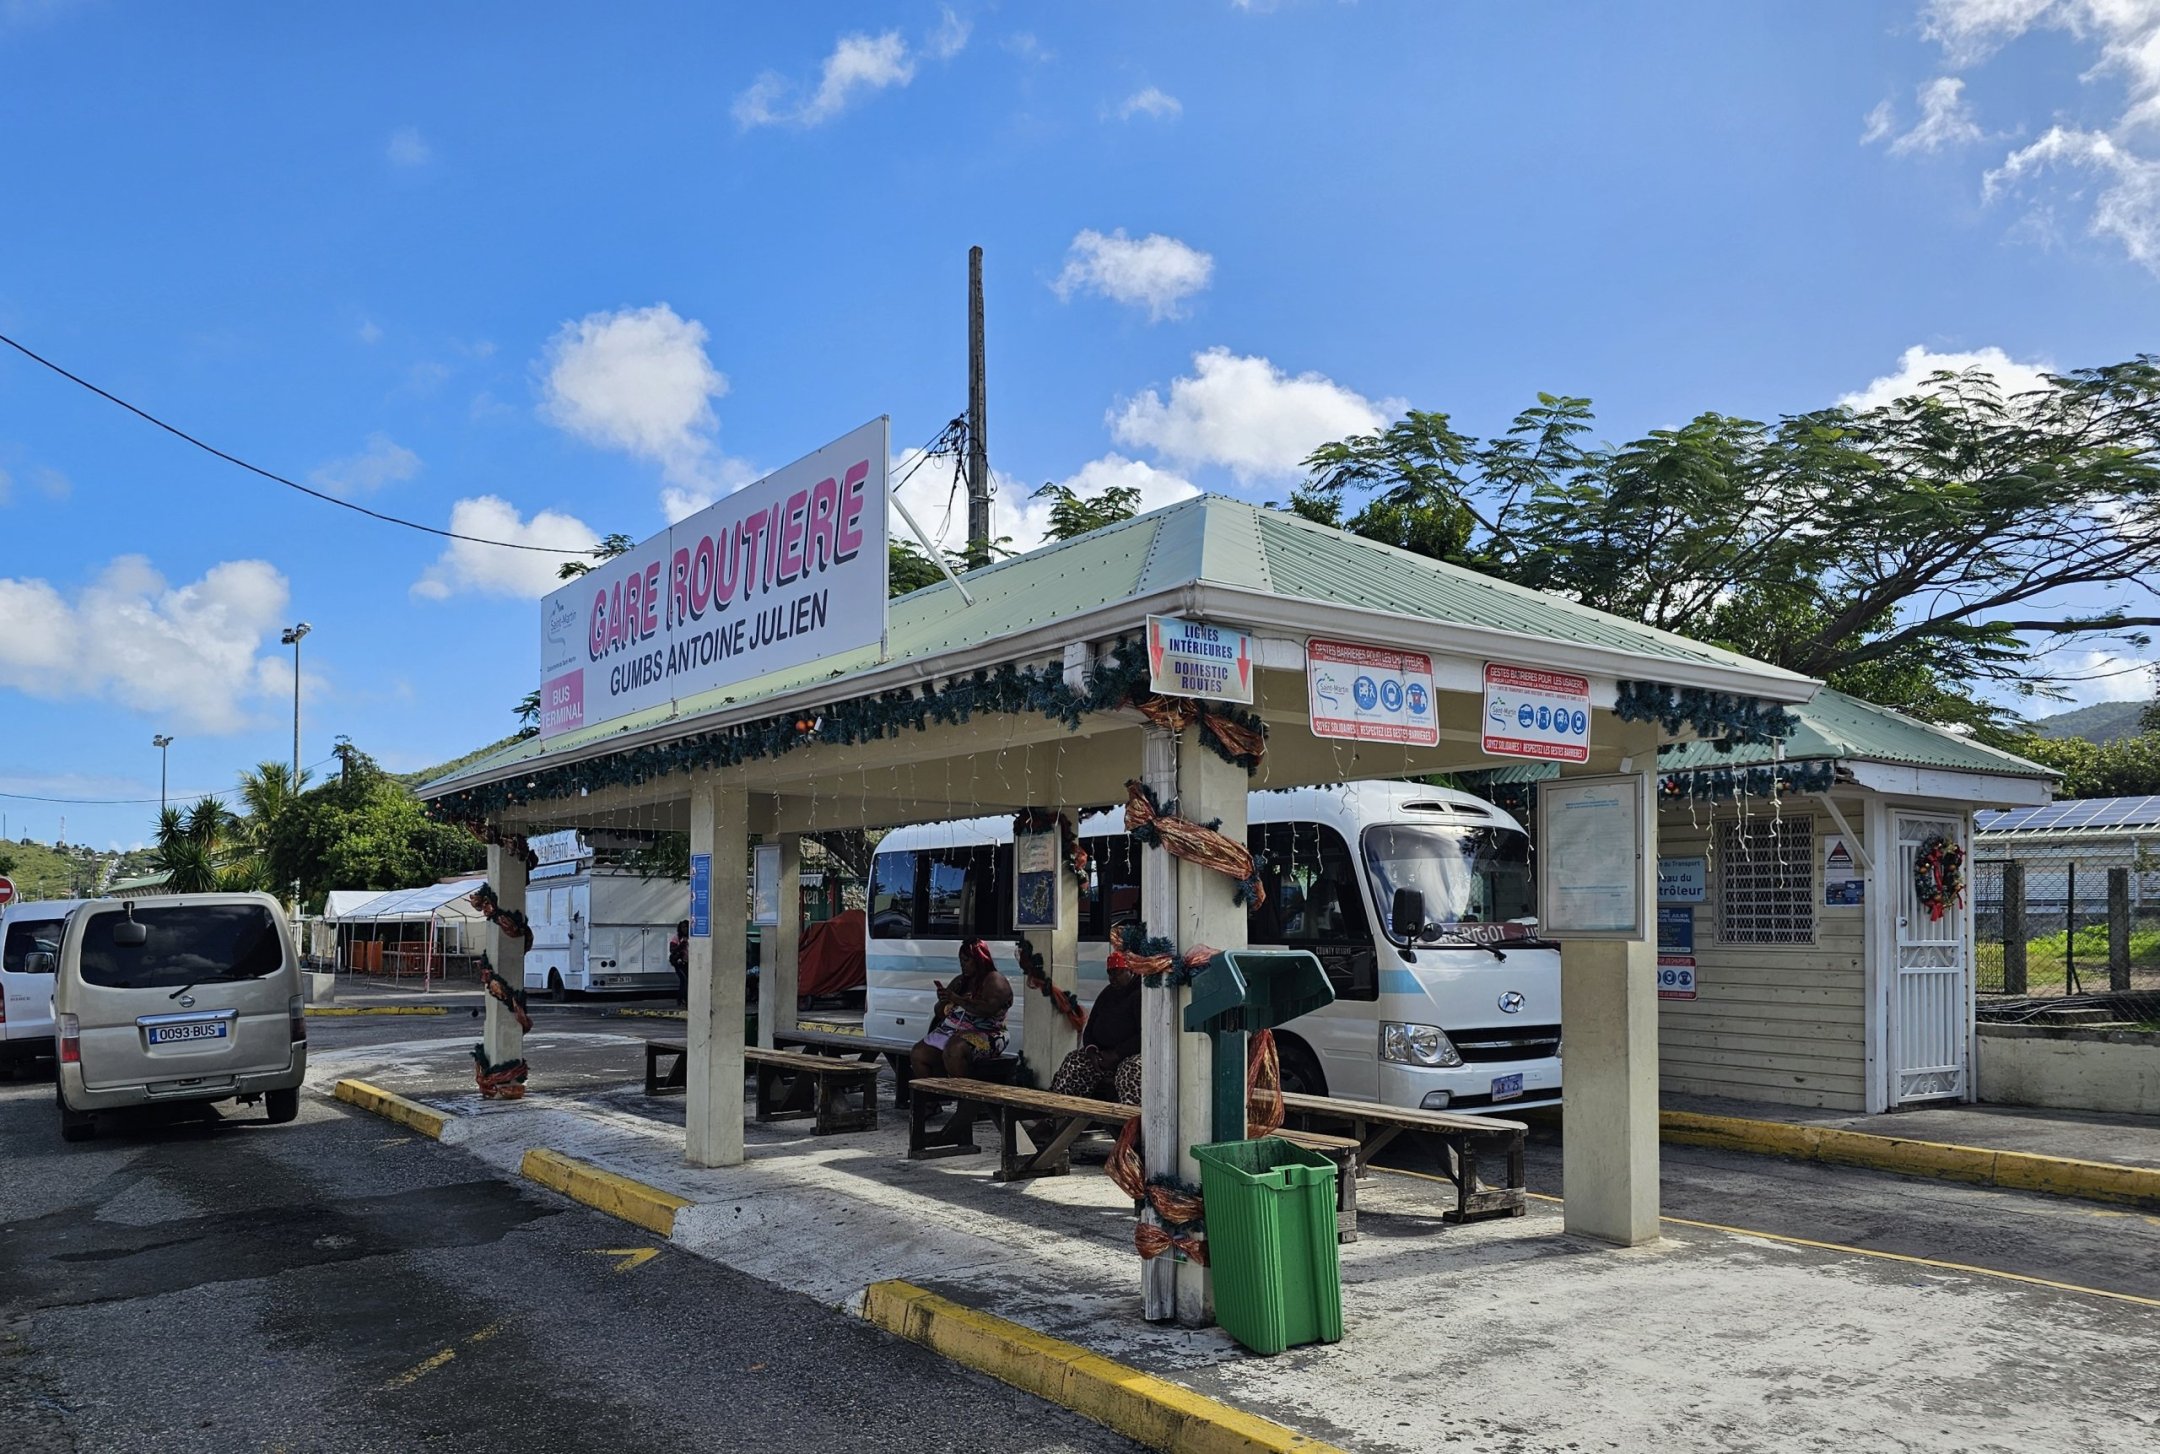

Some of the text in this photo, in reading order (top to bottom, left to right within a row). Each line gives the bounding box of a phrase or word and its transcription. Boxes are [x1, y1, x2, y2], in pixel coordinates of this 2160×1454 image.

[589, 459, 868, 662] GARE ROUTIERE
[610, 588, 828, 696] GUMBS ANTOINE JULIEN
[1169, 638, 1233, 659] INTÉRIEURES
[1175, 661, 1228, 680] DOMESTIC
[1490, 666, 1510, 678] GESTES
[1538, 673, 1552, 684] POUR
[1553, 676, 1562, 686] LES
[1181, 676, 1222, 692] ROUTES
[1320, 683, 1349, 693] Saint-Martin
[552, 685, 571, 706] BUS
[541, 702, 583, 729] TERMINAL
[1360, 725, 1384, 737] RESPECTEZ
[1672, 860, 1701, 868] Transport
[1658, 873, 1692, 883] reau du
[1659, 884, 1703, 896] trôleur
